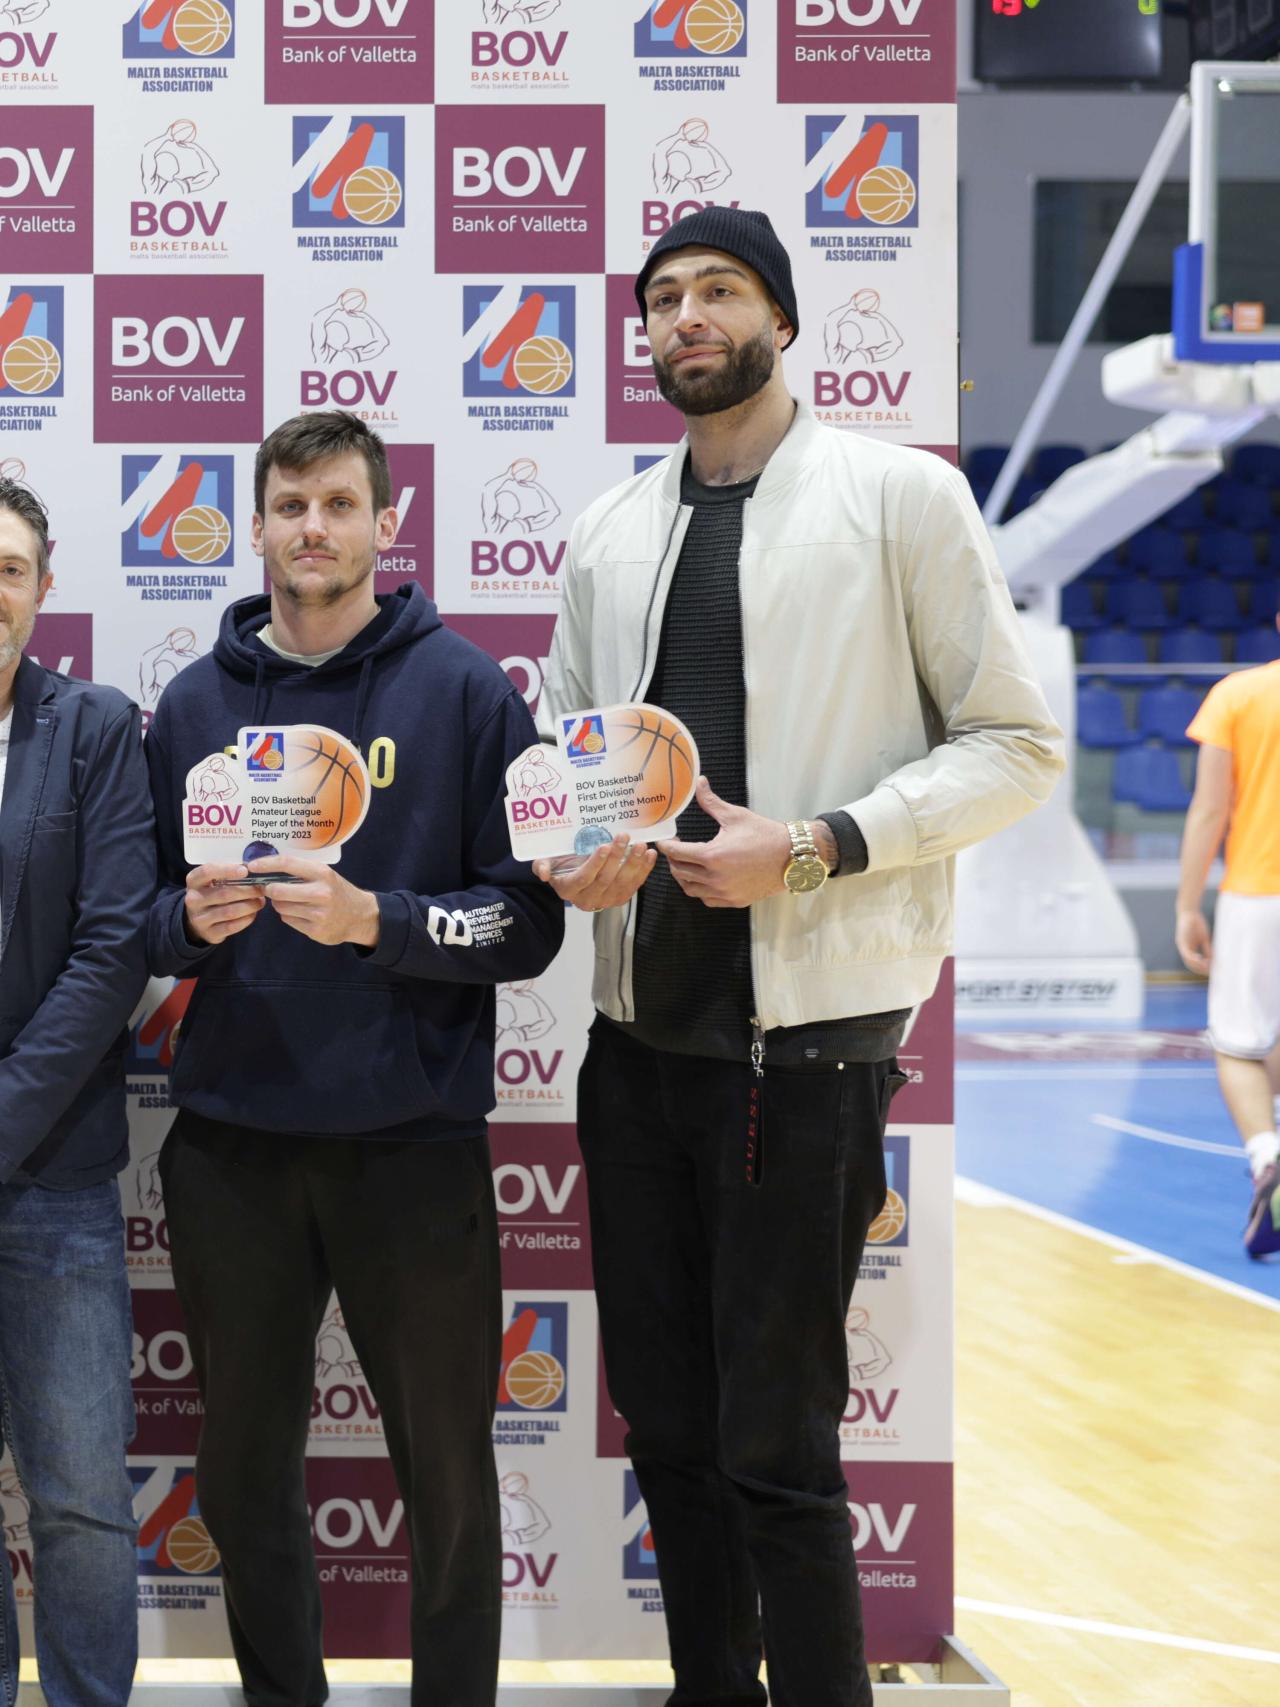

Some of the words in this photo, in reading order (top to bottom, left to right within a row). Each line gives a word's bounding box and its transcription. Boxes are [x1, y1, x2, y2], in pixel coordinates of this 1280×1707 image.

[471, 30, 569, 67] BOV
[795, 45, 838, 62] Bank
[841, 45, 860, 61] of
[864, 45, 931, 62] Valletta
[471, 71, 569, 81] BASKETBALL
[639, 66, 673, 77] MALTA
[675, 66, 741, 77] BASKETBALL
[654, 79, 725, 91] ASSOCIATION
[9, 216, 76, 233] Valletta
[810, 236, 844, 247] MALTA
[846, 236, 912, 247] BASKETBALL
[825, 250, 897, 261] ASSOCIATION
[814, 370, 911, 406] BOV
[471, 540, 569, 576] BOV
[126, 575, 160, 587] MALTA
[162, 575, 228, 587] BASKETBALL
[471, 581, 560, 590] BASKETBAL
[141, 589, 212, 600] ASSOCIATION
[576, 781, 596, 791] BOV
[598, 773, 643, 787] Basketball
[251, 796, 270, 804] BOV
[272, 796, 316, 804] Basketball
[578, 793, 597, 802] First
[600, 787, 634, 800] Division
[511, 794, 567, 822] BOV
[579, 803, 607, 814] Player
[609, 802, 619, 810] of
[620, 799, 634, 808] the
[637, 793, 666, 805] Month
[188, 805, 242, 826] BOV
[251, 808, 288, 816] Amateur
[290, 808, 321, 817] League
[581, 814, 620, 825] January
[619, 810, 639, 819] 2023
[252, 819, 277, 828] Player
[279, 819, 288, 827] of
[307, 819, 334, 828] Month
[514, 817, 572, 831] BASKETBALL
[252, 831, 290, 840] February
[292, 831, 311, 839] 2023
[465, 902, 505, 918] AUTOMATED
[468, 912, 501, 925] REVENUE
[470, 916, 513, 934] MANAGEMENT
[476, 936, 505, 948] LIMITED
[492, 1164, 581, 1214] OV
[515, 1232, 582, 1249] Valletta
